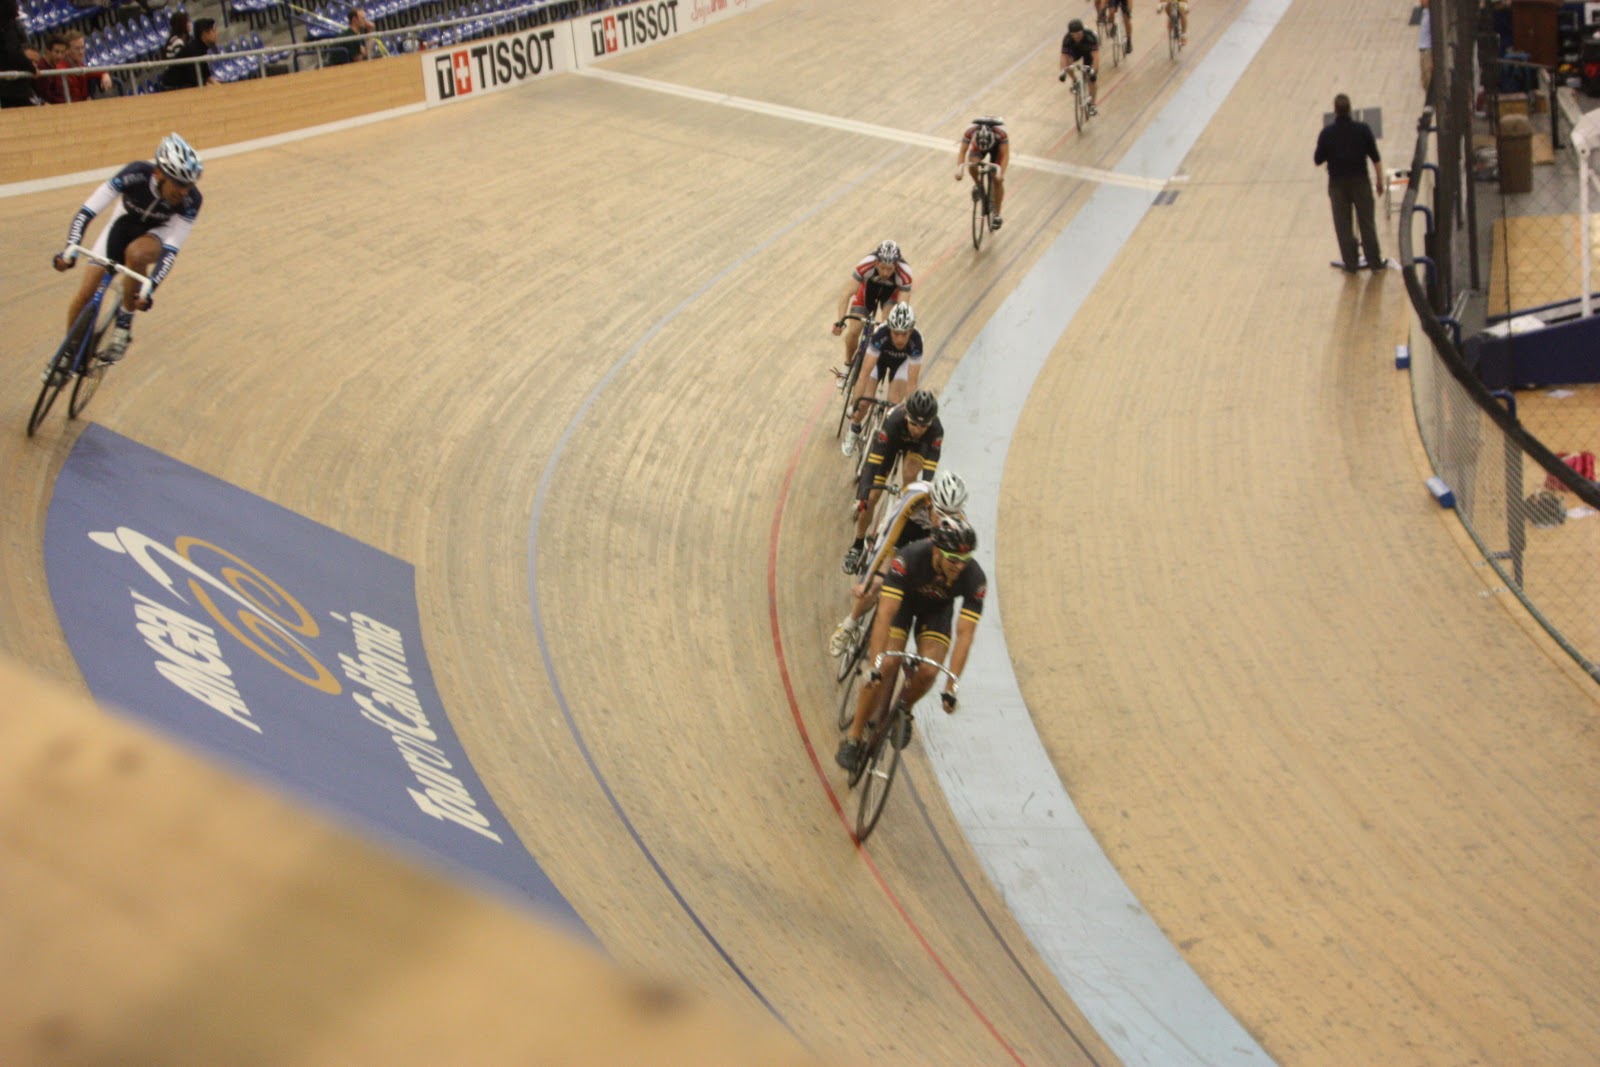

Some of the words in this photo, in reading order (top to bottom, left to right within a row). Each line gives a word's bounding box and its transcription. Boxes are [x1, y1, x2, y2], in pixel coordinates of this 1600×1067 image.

[472, 30, 555, 89] TISSOT
[618, 0, 678, 48] TISSOT
[129, 587, 263, 734] AMGEN
[329, 611, 437, 742] California
[398, 747, 503, 844] Tour
